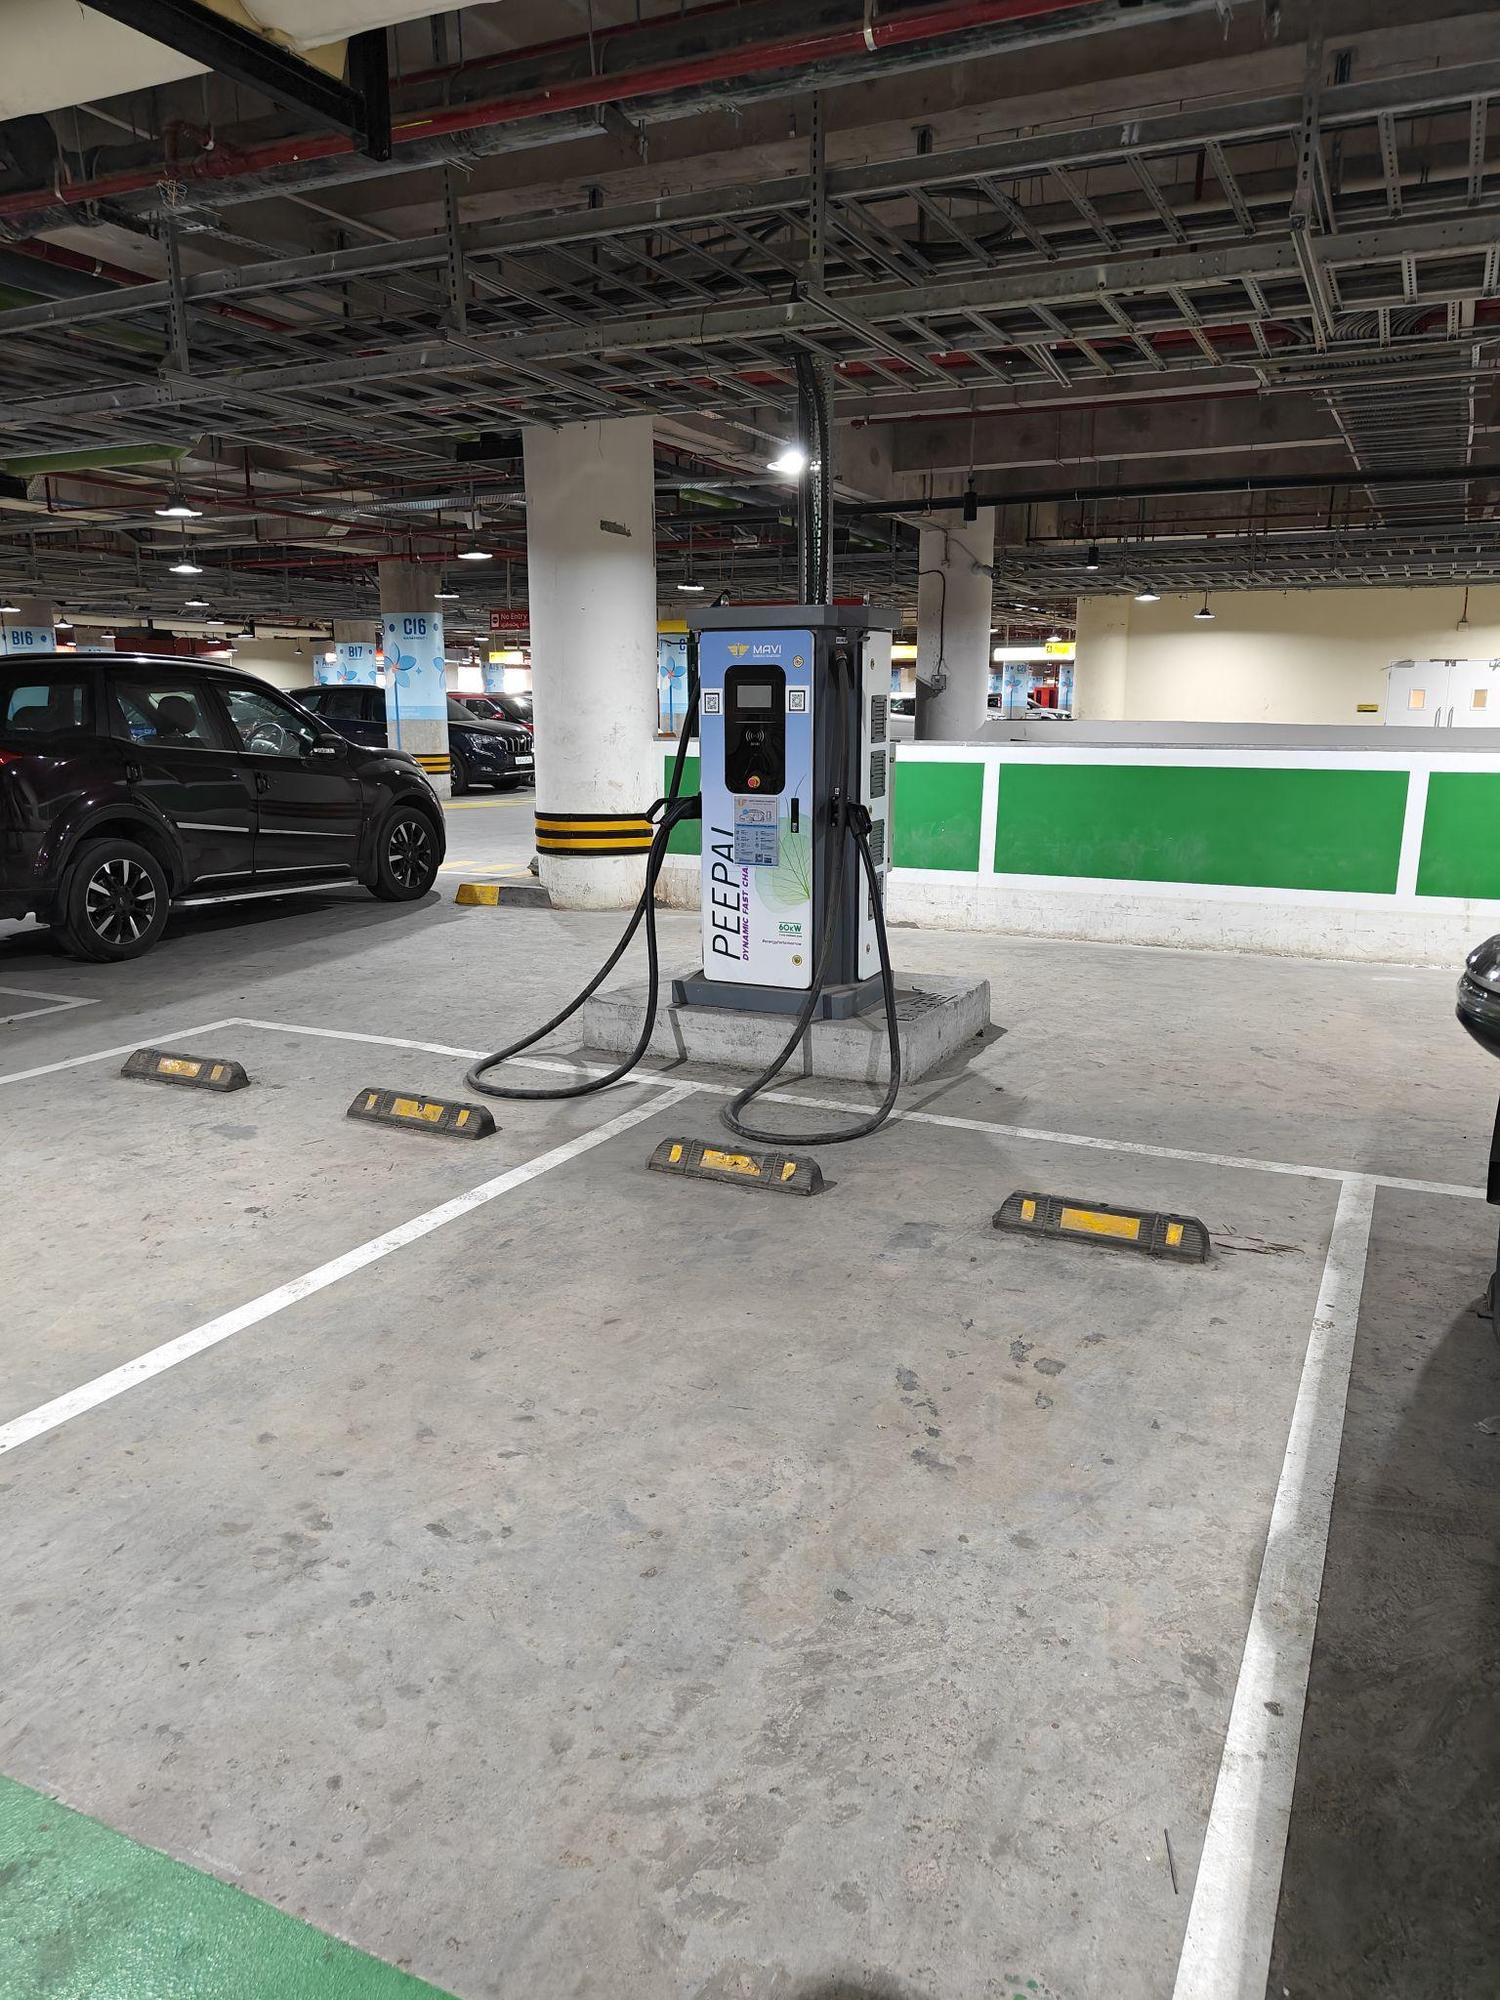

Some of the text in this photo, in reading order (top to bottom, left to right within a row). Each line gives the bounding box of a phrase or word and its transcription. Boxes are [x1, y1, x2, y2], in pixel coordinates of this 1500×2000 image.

[403, 618, 426, 635] C16
[12, 631, 33, 645] B16
[348, 645, 363, 658] B17
[753, 644, 782, 654] MAVI
